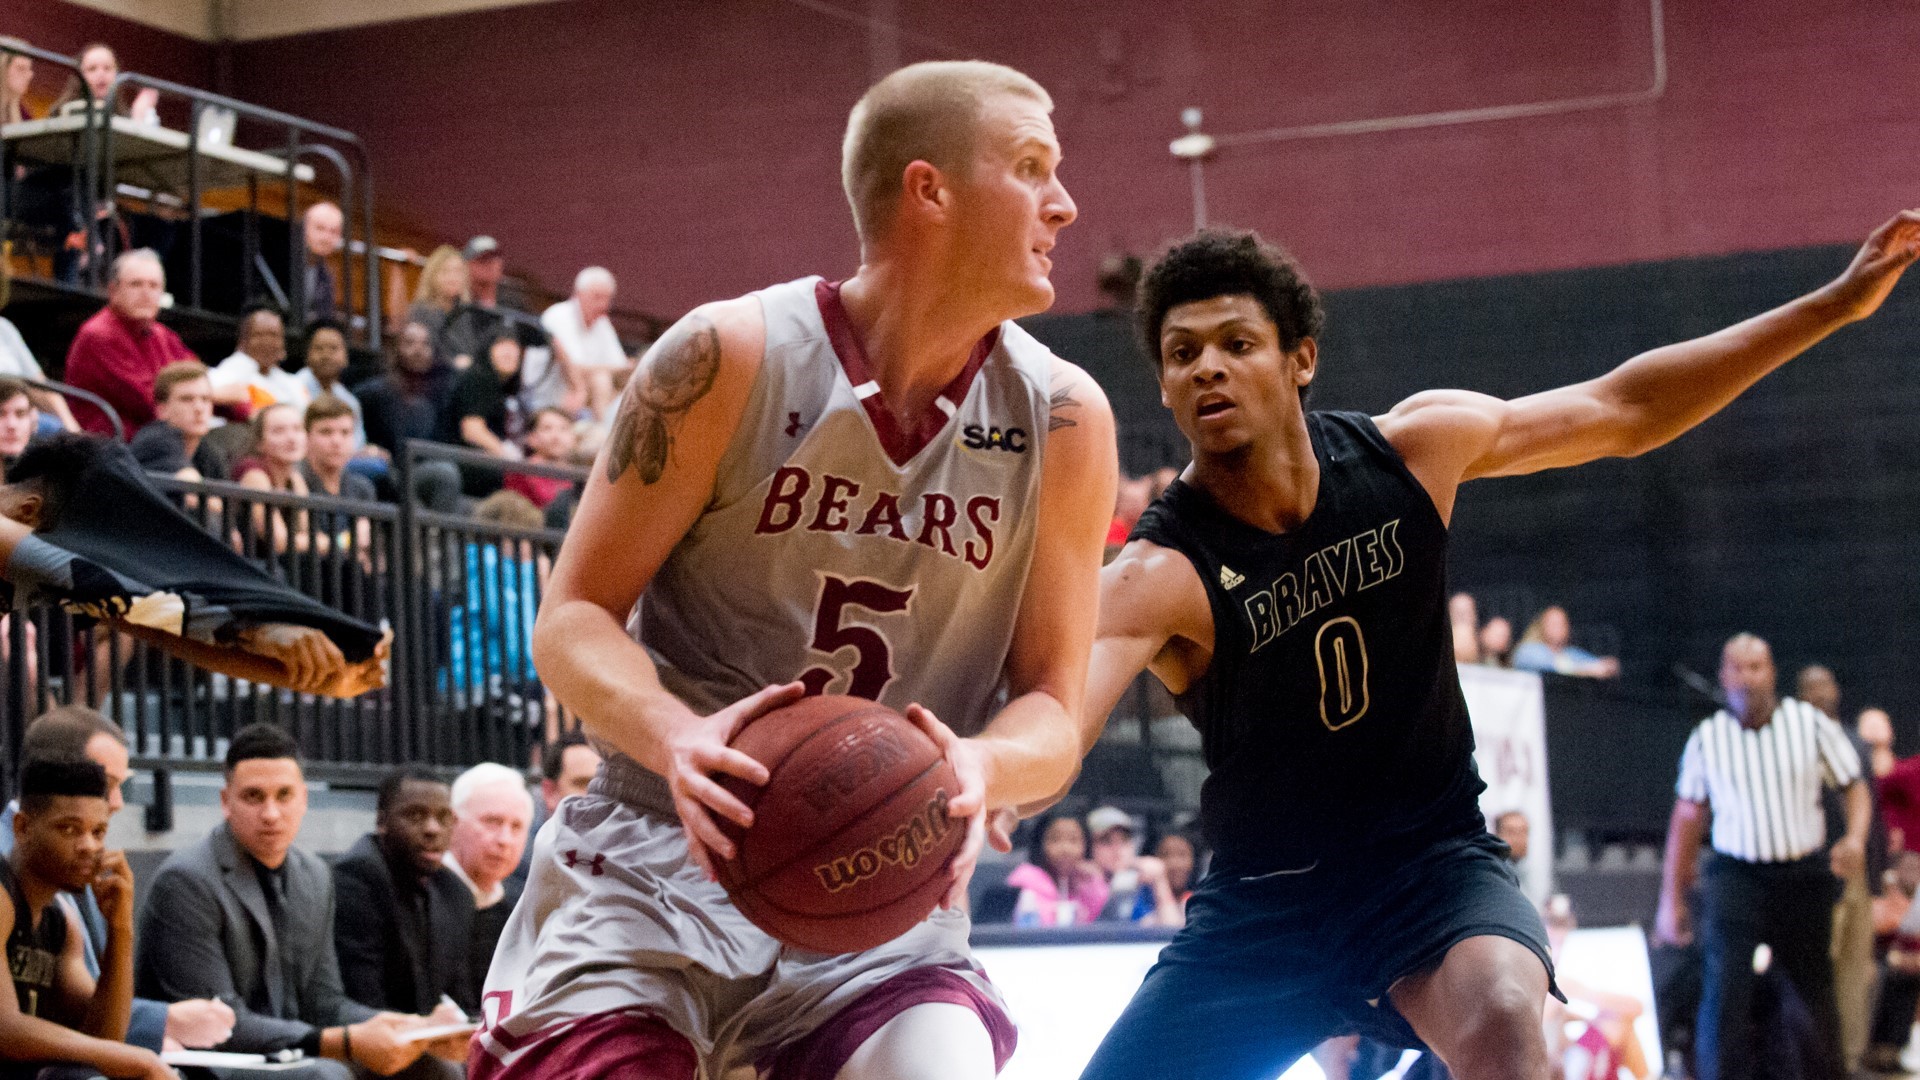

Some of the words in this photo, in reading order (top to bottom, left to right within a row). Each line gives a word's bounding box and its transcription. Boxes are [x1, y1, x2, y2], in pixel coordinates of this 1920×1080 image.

[963, 424, 1026, 453] SAC
[754, 465, 1001, 571] BEARS
[798, 569, 918, 702] 5
[1244, 518, 1404, 653] BRAVES
[1315, 616, 1369, 731] 0
[813, 787, 951, 893] Wilson
